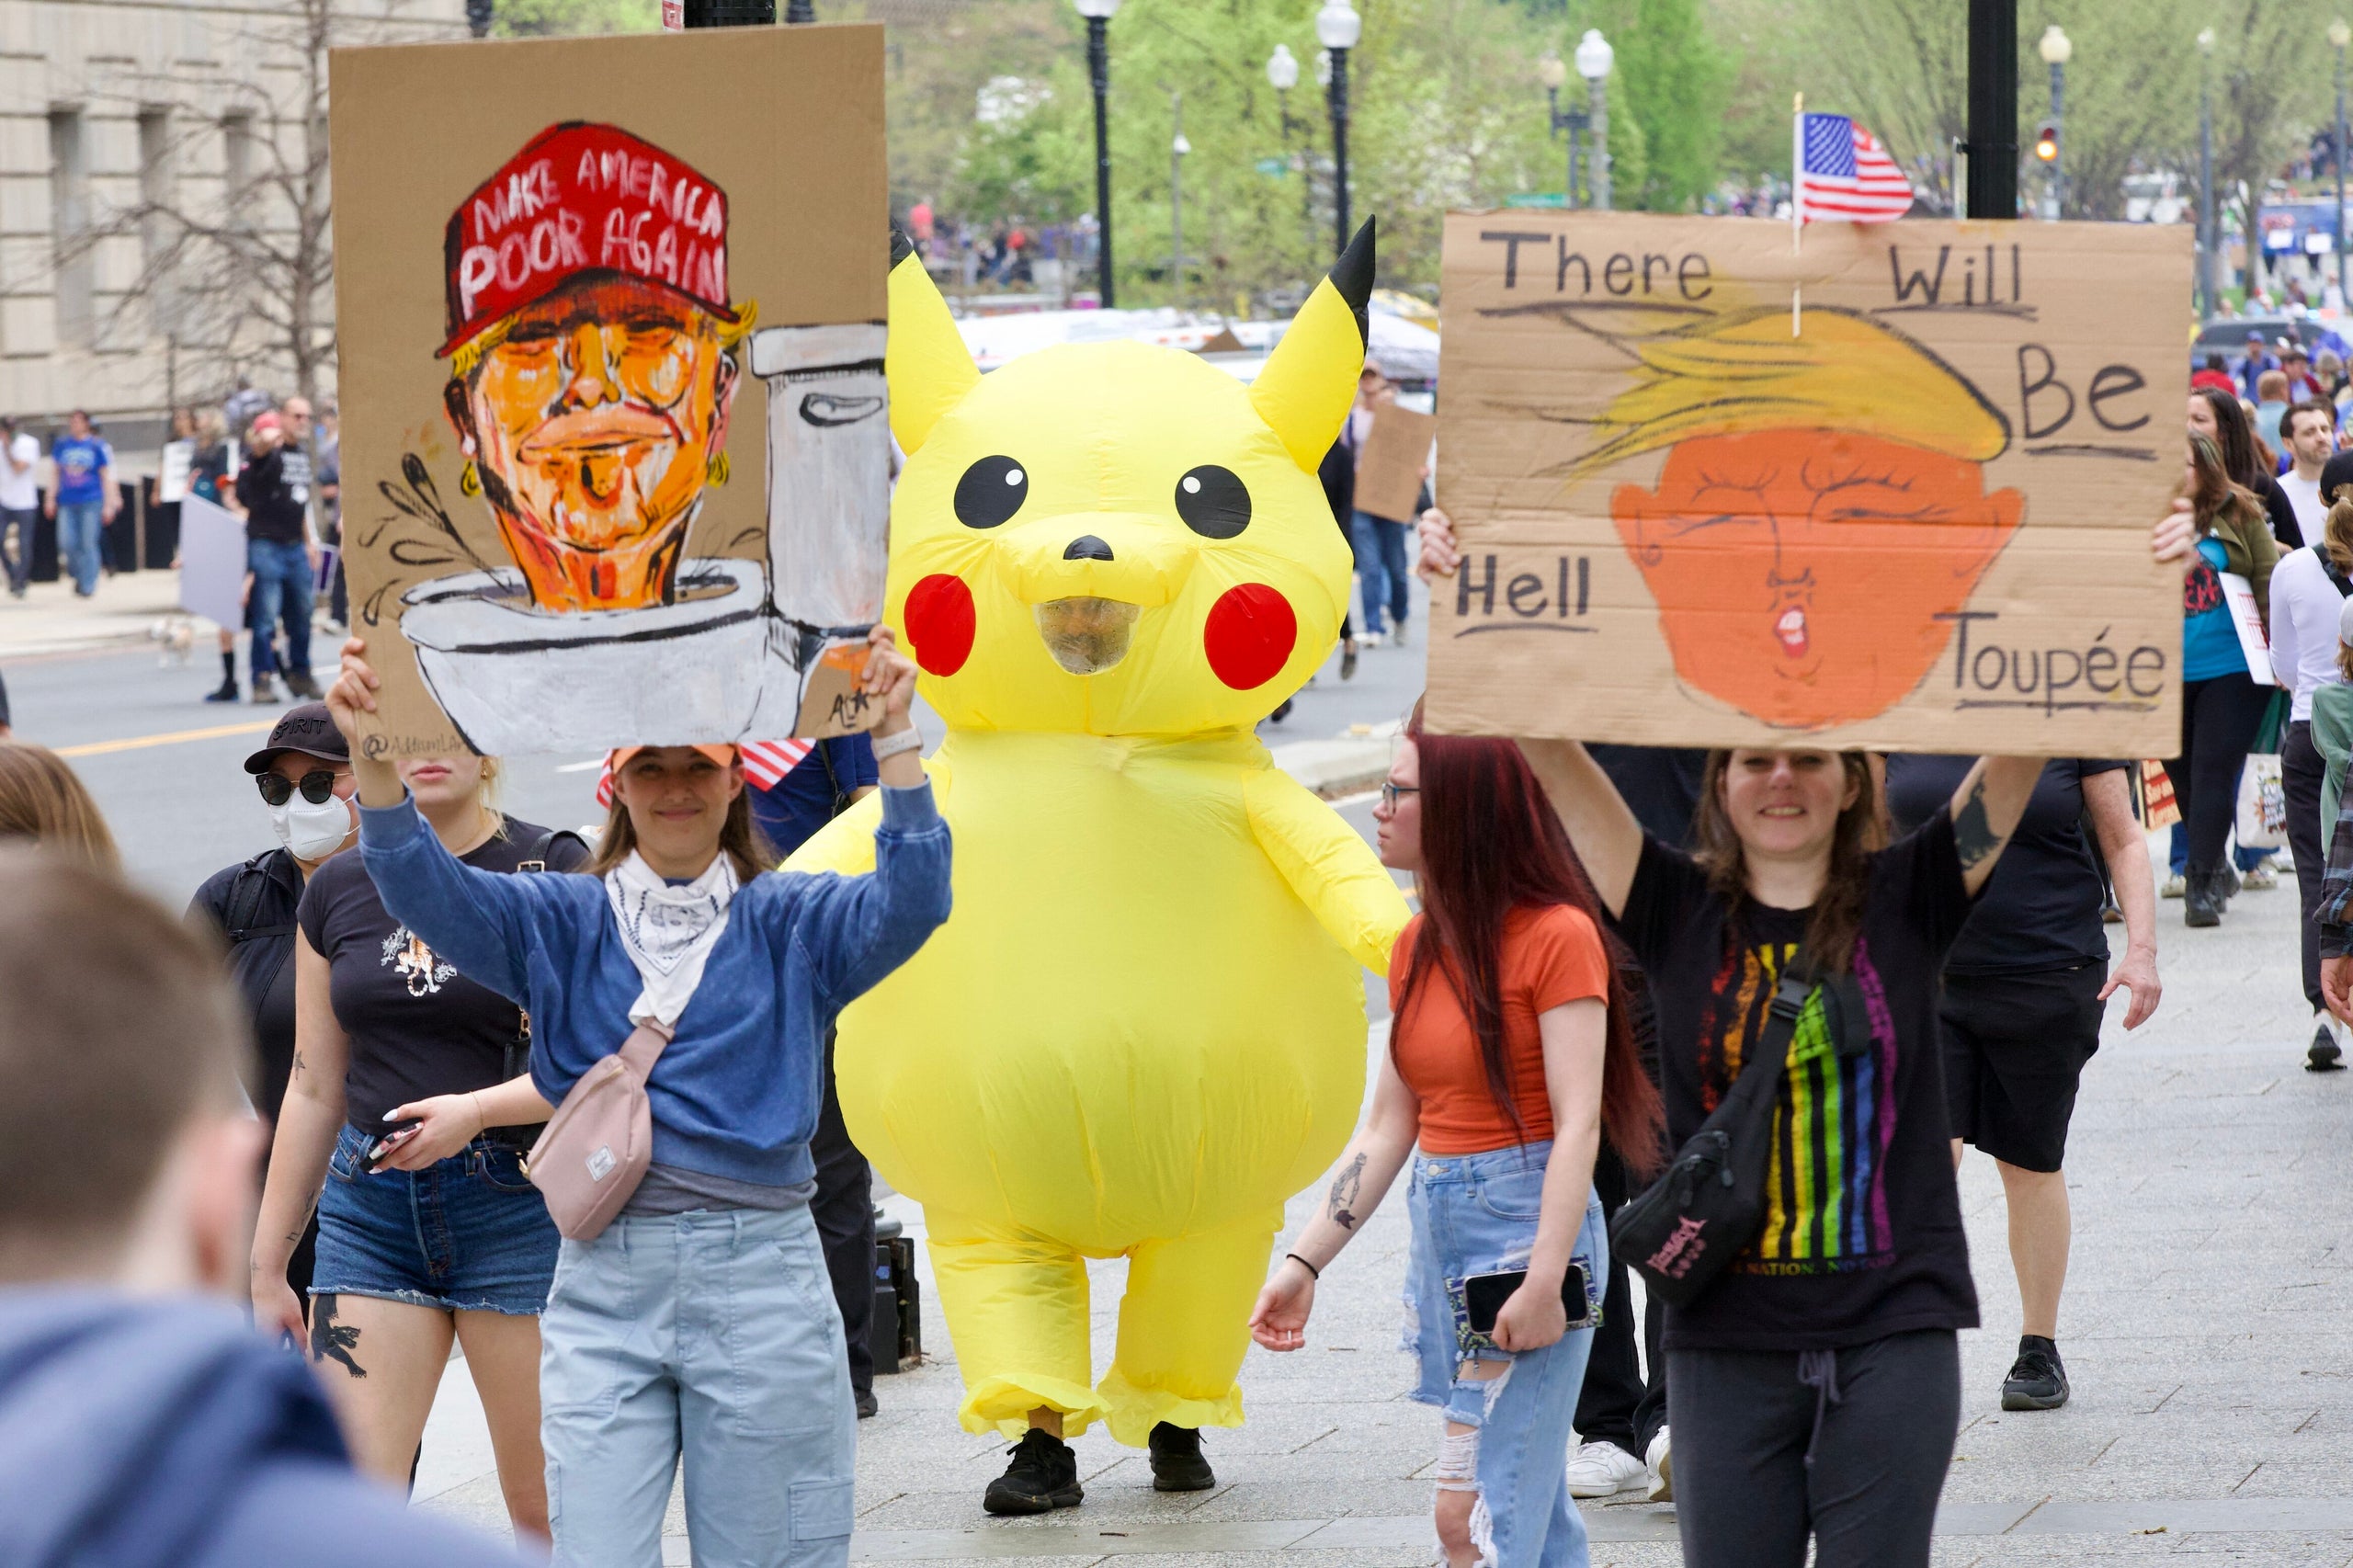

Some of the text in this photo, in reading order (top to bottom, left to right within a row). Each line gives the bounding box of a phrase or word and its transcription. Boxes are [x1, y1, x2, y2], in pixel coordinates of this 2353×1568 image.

[472, 147, 723, 243] MAKE AMERICA
[460, 206, 726, 323] POOR AGAIN
[1480, 231, 2021, 307] There Will
[2018, 343, 2152, 439] Be
[1456, 553, 1589, 619] Hell
[1932, 611, 2165, 719] Toupée
[273, 717, 327, 741] SPIRIT
